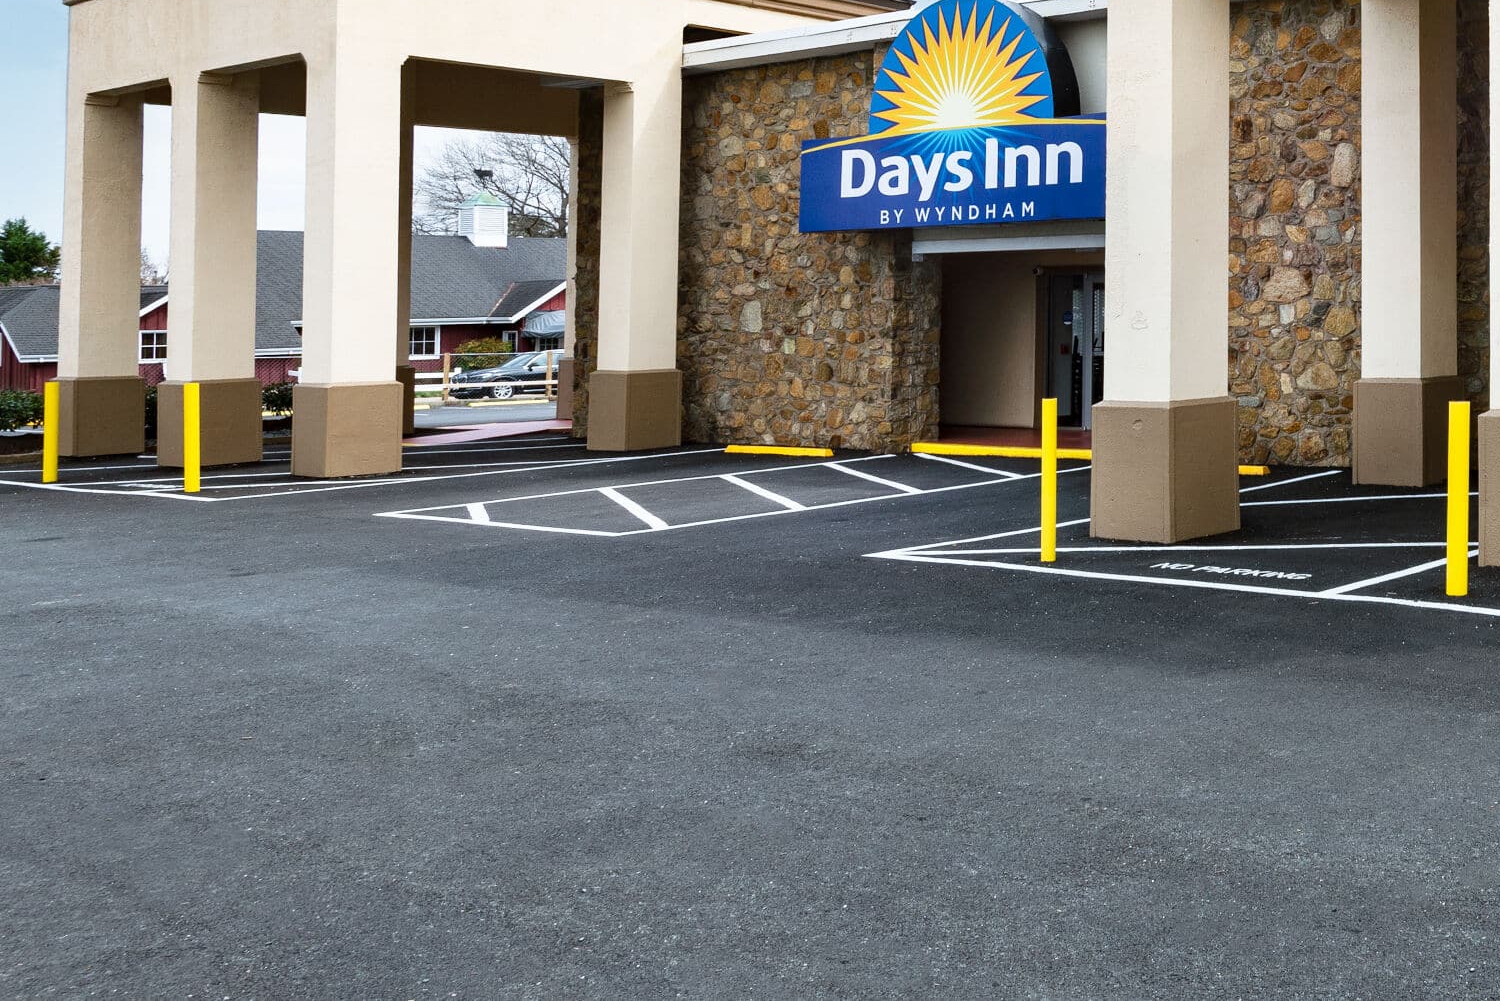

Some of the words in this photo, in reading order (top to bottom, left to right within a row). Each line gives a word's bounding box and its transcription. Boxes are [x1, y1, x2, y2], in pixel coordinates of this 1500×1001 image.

[840, 149, 973, 202] Days
[984, 137, 1084, 190] Inn
[880, 209, 904, 225] BY
[915, 201, 1035, 224] WYNDHAM
[1150, 562, 1194, 570] NO
[1192, 565, 1312, 580] PARKING
